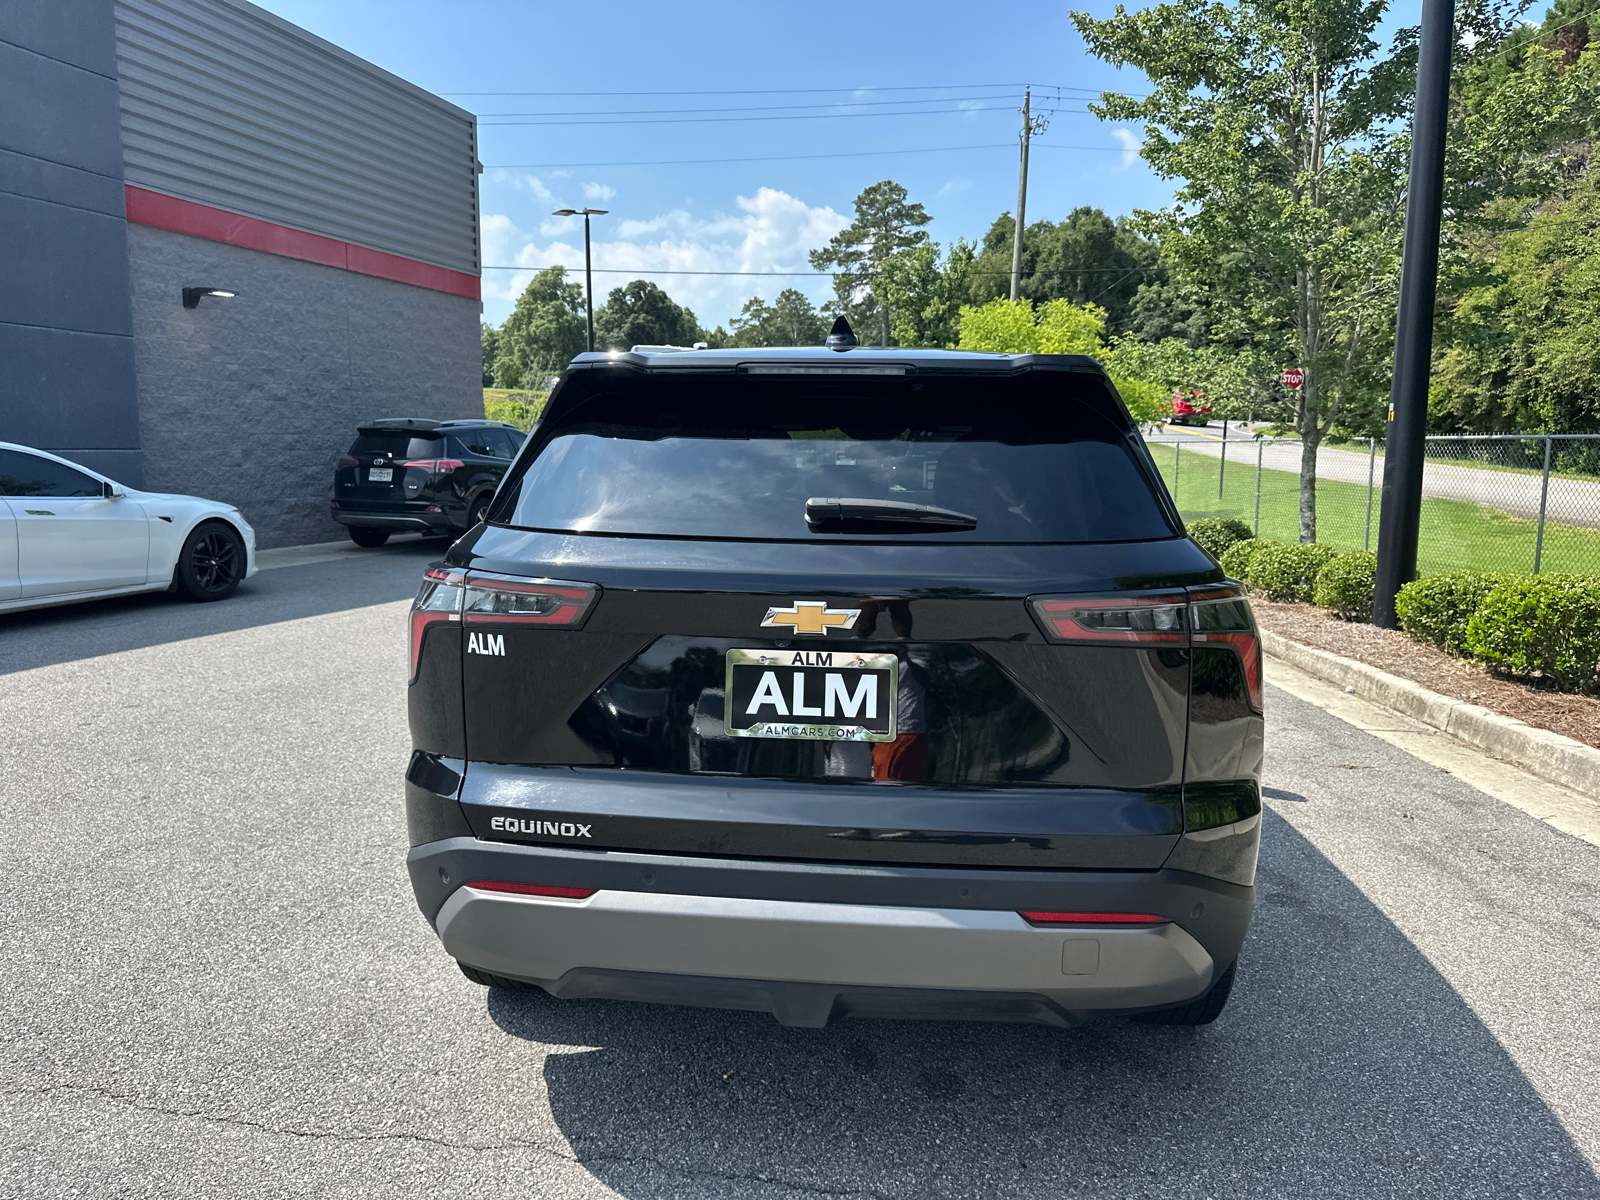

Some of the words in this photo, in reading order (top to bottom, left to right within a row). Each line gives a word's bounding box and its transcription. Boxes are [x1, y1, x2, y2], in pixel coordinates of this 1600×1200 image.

[1282, 374, 1302, 383] STOP
[468, 632, 505, 656] ALM
[791, 652, 833, 667] ALM
[745, 671, 878, 719] ALM
[765, 725, 856, 738] ALMCARS.COM
[491, 817, 592, 838] EQUINOX
